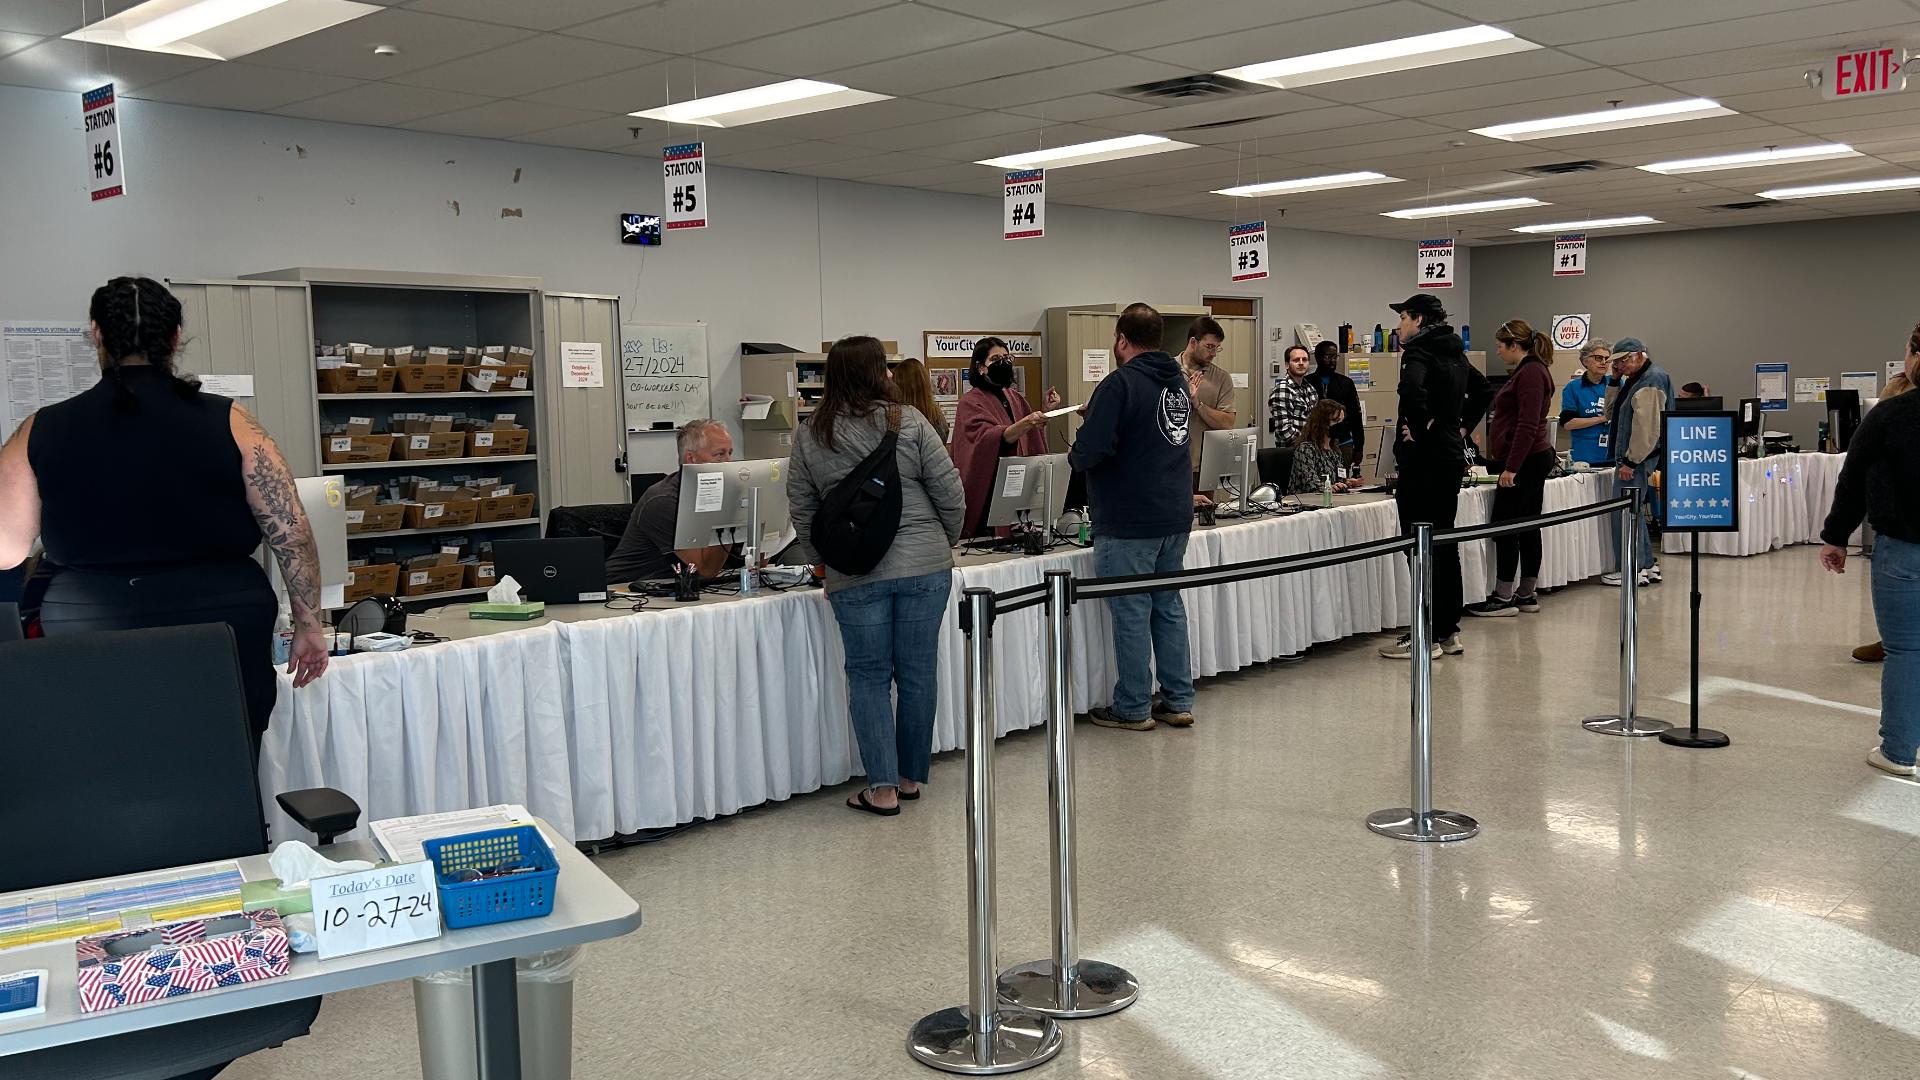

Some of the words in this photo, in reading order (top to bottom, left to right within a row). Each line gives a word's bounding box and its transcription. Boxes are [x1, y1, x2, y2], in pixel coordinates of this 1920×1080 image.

[1836, 48, 1894, 96] EXIT
[84, 107, 116, 132] STATION
[94, 140, 114, 179] #6
[665, 160, 703, 177] STATION
[673, 185, 697, 212] #5
[1006, 183, 1042, 197] STATION
[1012, 202, 1036, 226] #4
[1231, 233, 1265, 246] STATION
[1556, 242, 1585, 250] STATION
[1238, 250, 1260, 270] #3
[1420, 249, 1452, 258] STATION
[1560, 253, 1578, 267] #1
[1425, 262, 1446, 279] #2
[1680, 425, 1717, 440] LINE
[1670, 449, 1728, 464] FORMS
[1678, 473, 1721, 488] HERE
[326, 480, 342, 509] 6
[328, 876, 382, 897] Today's
[385, 872, 416, 888] Date
